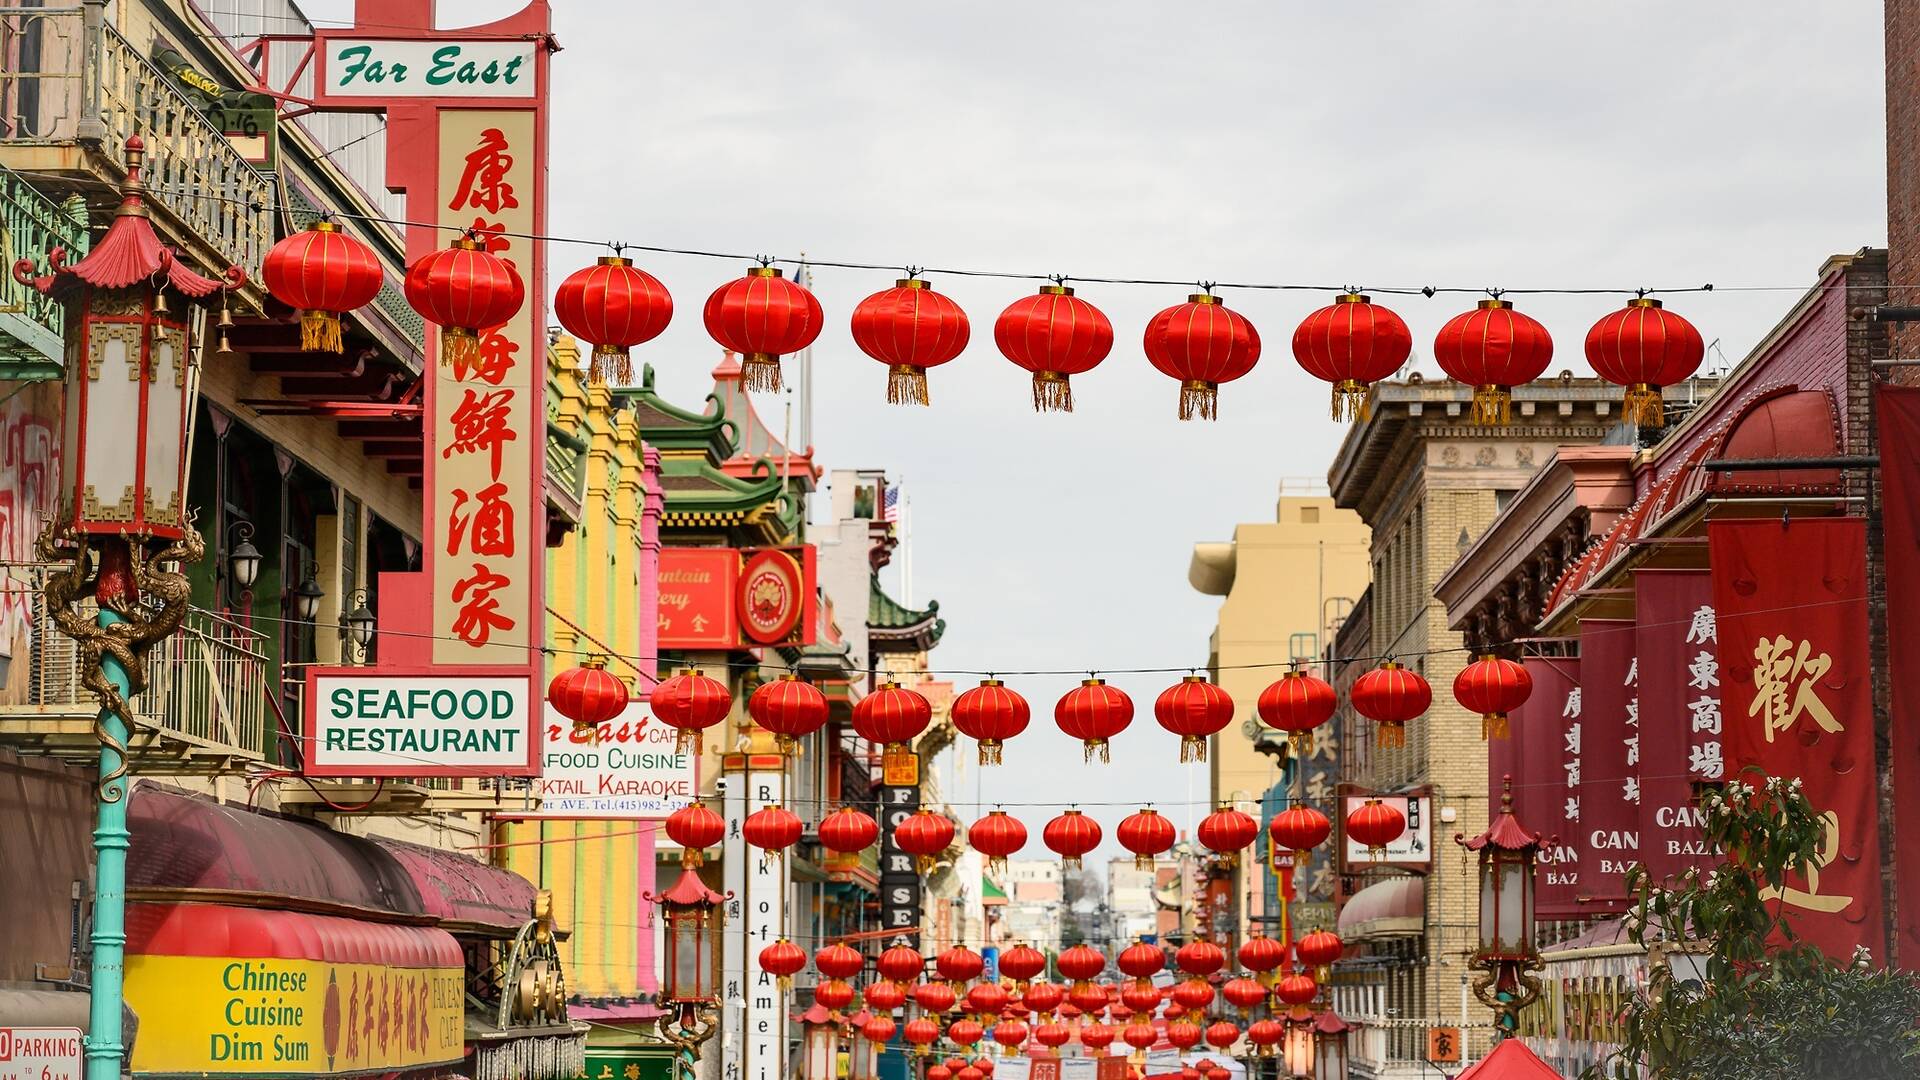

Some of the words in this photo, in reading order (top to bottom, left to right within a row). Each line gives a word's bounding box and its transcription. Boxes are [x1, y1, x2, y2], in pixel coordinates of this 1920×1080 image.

[338, 46, 407, 86] Far
[425, 46, 522, 85] East
[330, 687, 514, 720] SEAFOOD
[1686, 605, 1725, 779] 廣東商場
[325, 728, 520, 752] RESTAURANT
[649, 728, 687, 744] CAF
[543, 753, 599, 768] FOOD
[541, 780, 590, 795] KTAIL
[598, 774, 689, 796] KARAOKE
[560, 800, 590, 810] AVE.
[759, 785, 770, 875] Bk
[223, 963, 307, 992] Chinese
[225, 998, 303, 1026] Cuisine
[15, 1038, 77, 1057] PARKING
[210, 1032, 263, 1061] Dim
[274, 1034, 309, 1061] Sum
